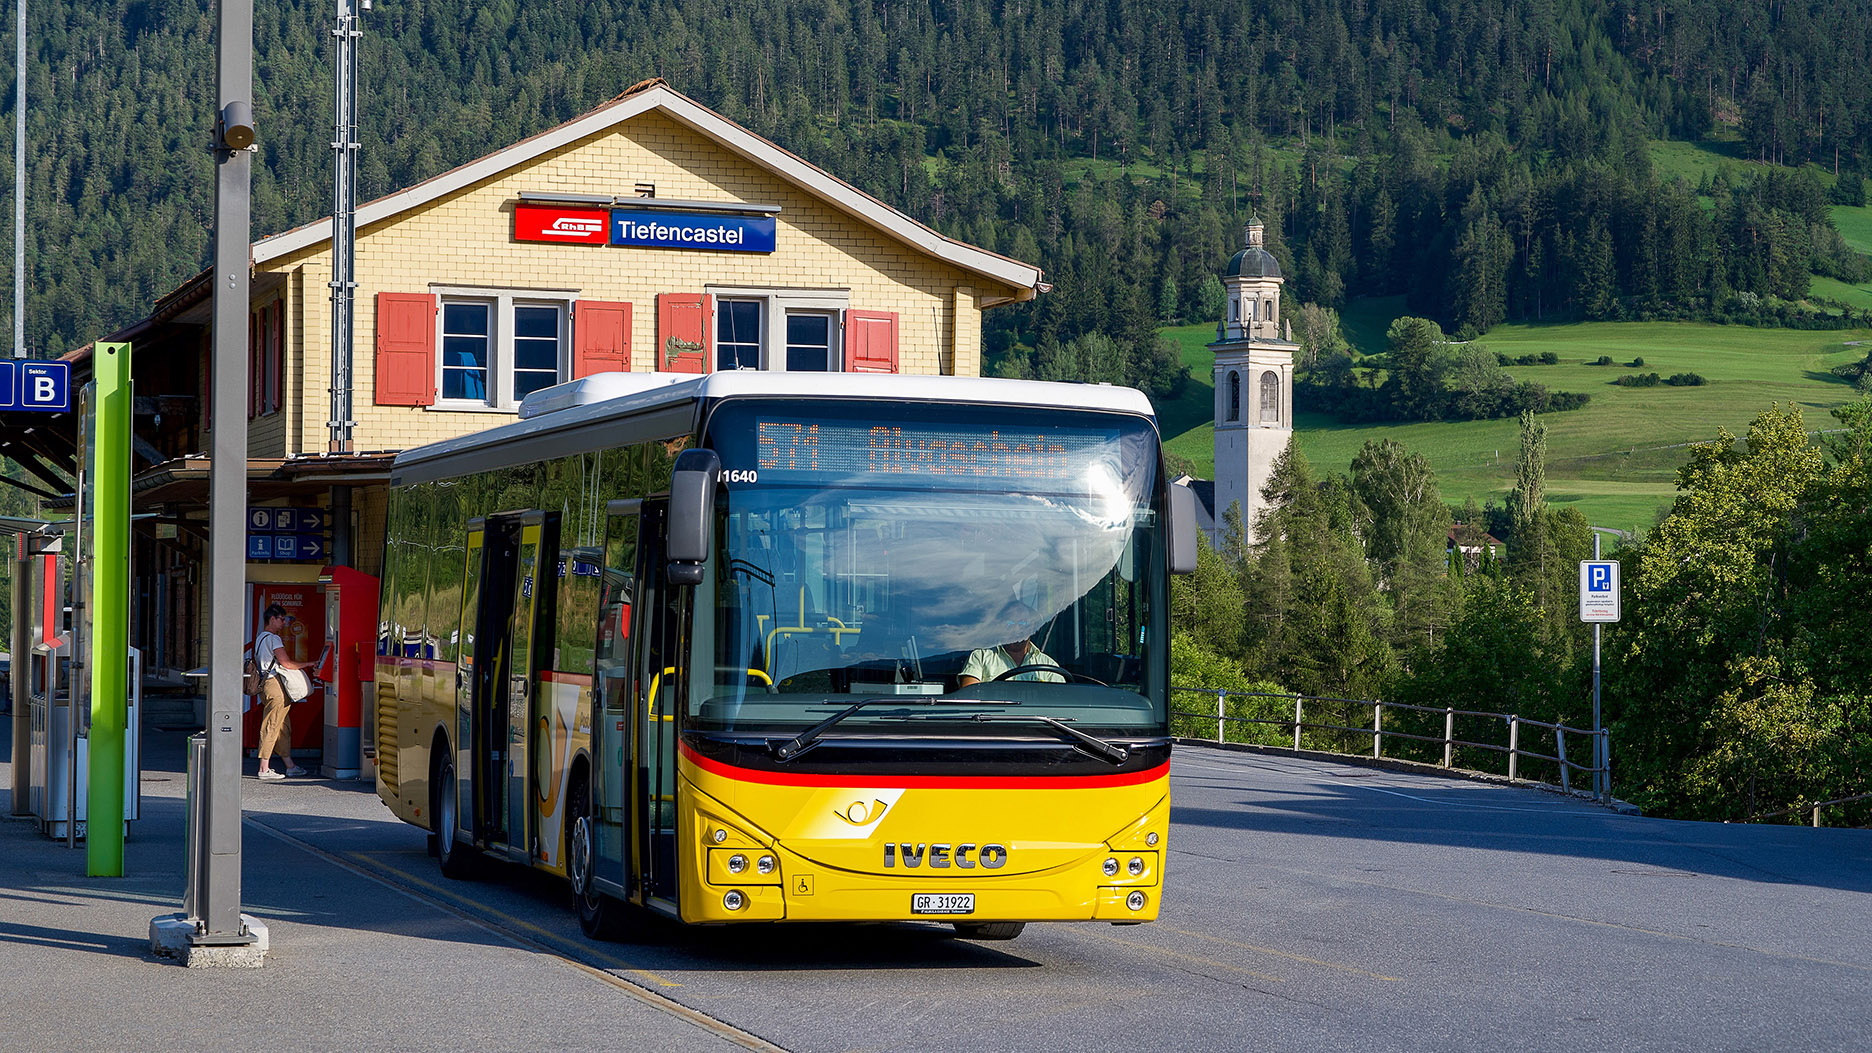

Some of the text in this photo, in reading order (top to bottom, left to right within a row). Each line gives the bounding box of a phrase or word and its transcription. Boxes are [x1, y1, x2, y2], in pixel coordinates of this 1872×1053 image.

[617, 220, 744, 245] Tiefencastel
[34, 376, 56, 402] B
[758, 422, 819, 471] 571
[1594, 568, 1605, 588] P
[883, 842, 1008, 869] IVECO
[917, 896, 970, 908] GR 31922
